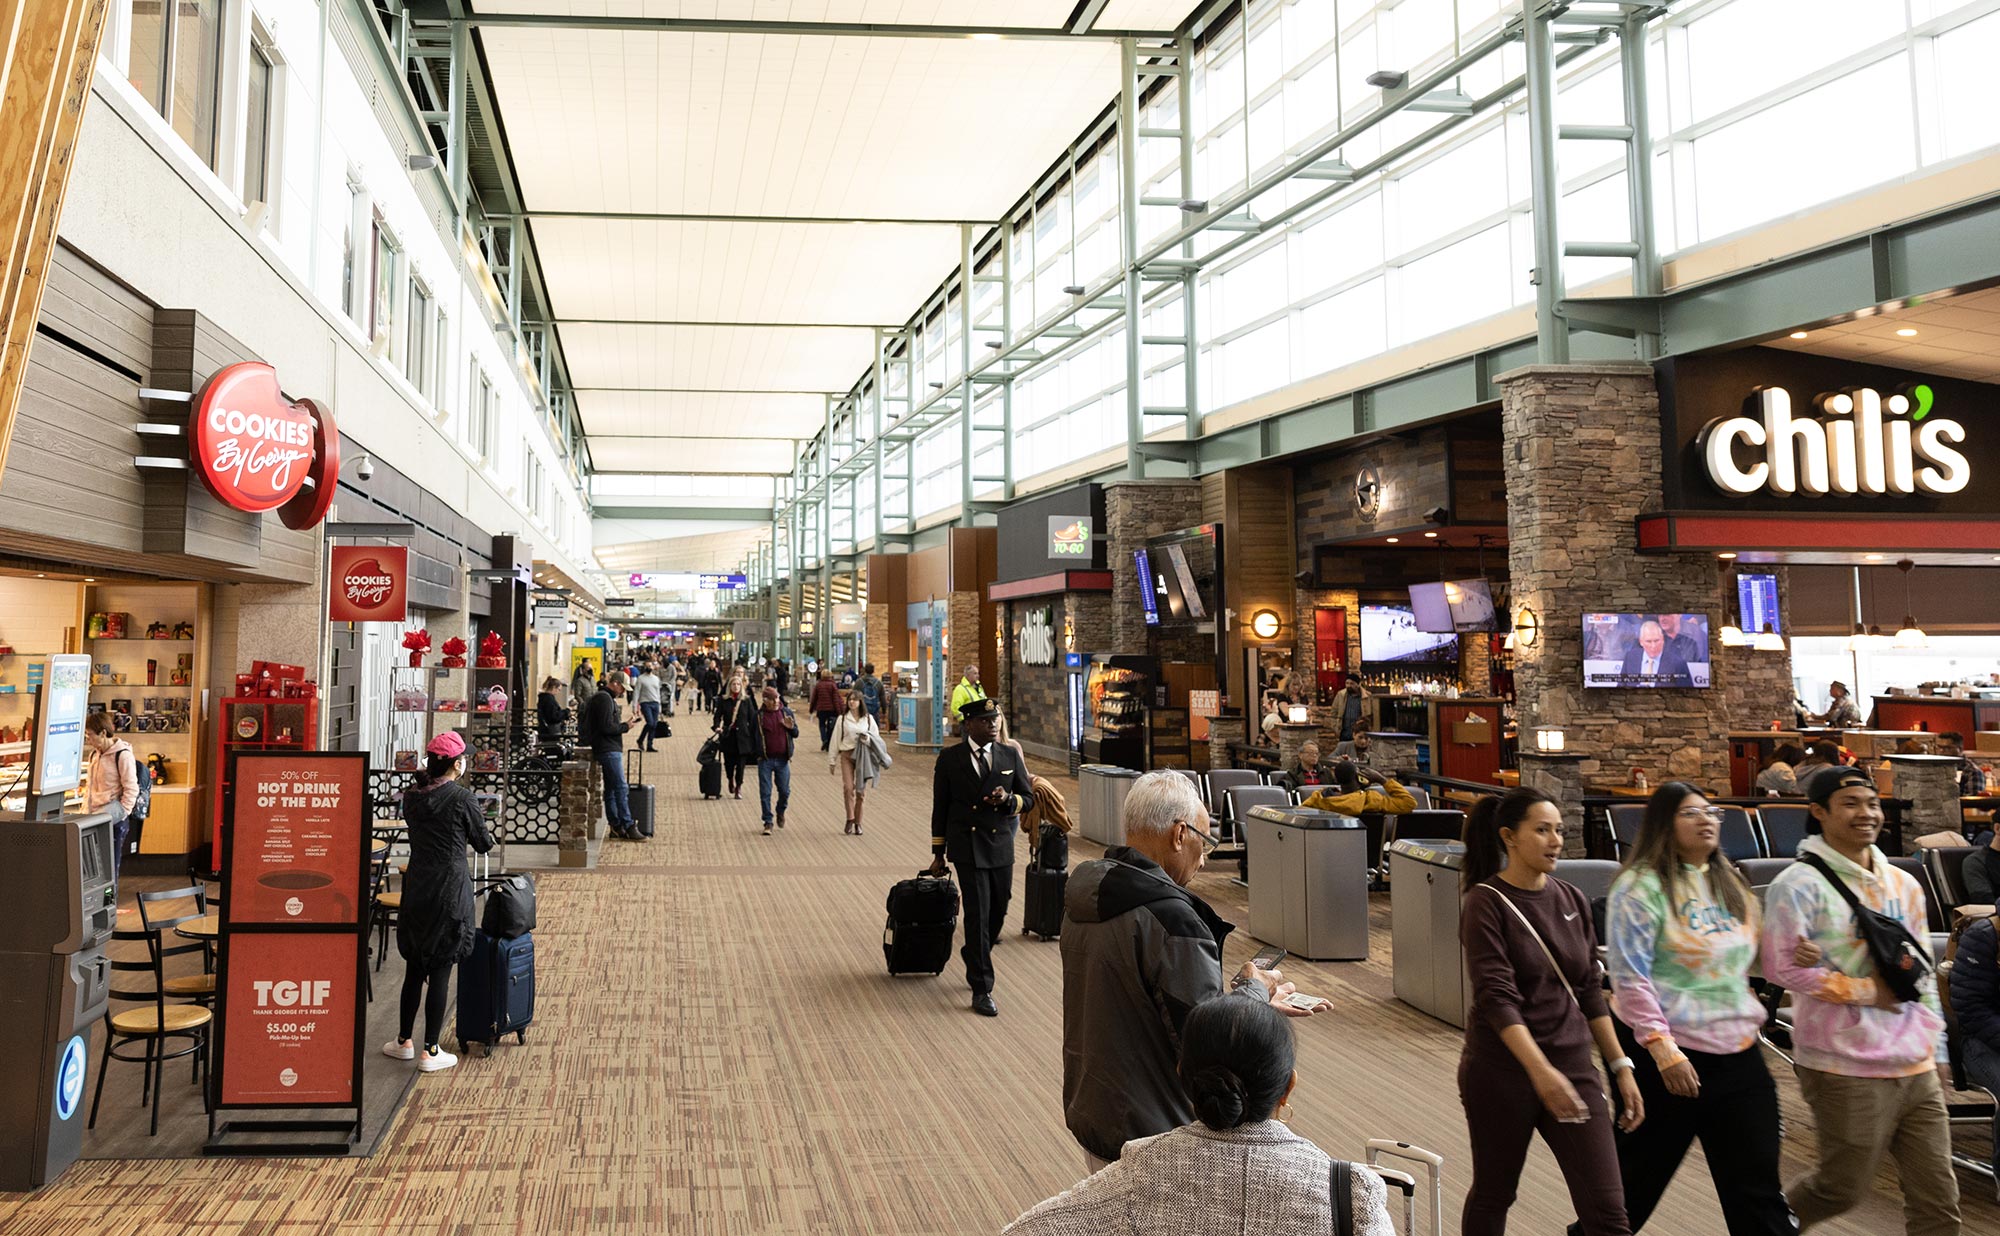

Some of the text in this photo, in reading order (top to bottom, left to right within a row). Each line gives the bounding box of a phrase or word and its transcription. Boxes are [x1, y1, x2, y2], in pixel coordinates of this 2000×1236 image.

[210, 407, 309, 447] COOKIES
[1706, 385, 1971, 493] chili's
[212, 438, 309, 491] By George
[344, 575, 392, 586] COOKIES
[347, 585, 392, 603] By George
[1191, 697, 1217, 708] SEAT
[280, 771, 319, 780] 50% OFF
[257, 782, 341, 794] HOT DRINK
[257, 796, 340, 809] OF THE DAY
[253, 980, 331, 1007] TGIF
[266, 1022, 316, 1034] $5.00 off
